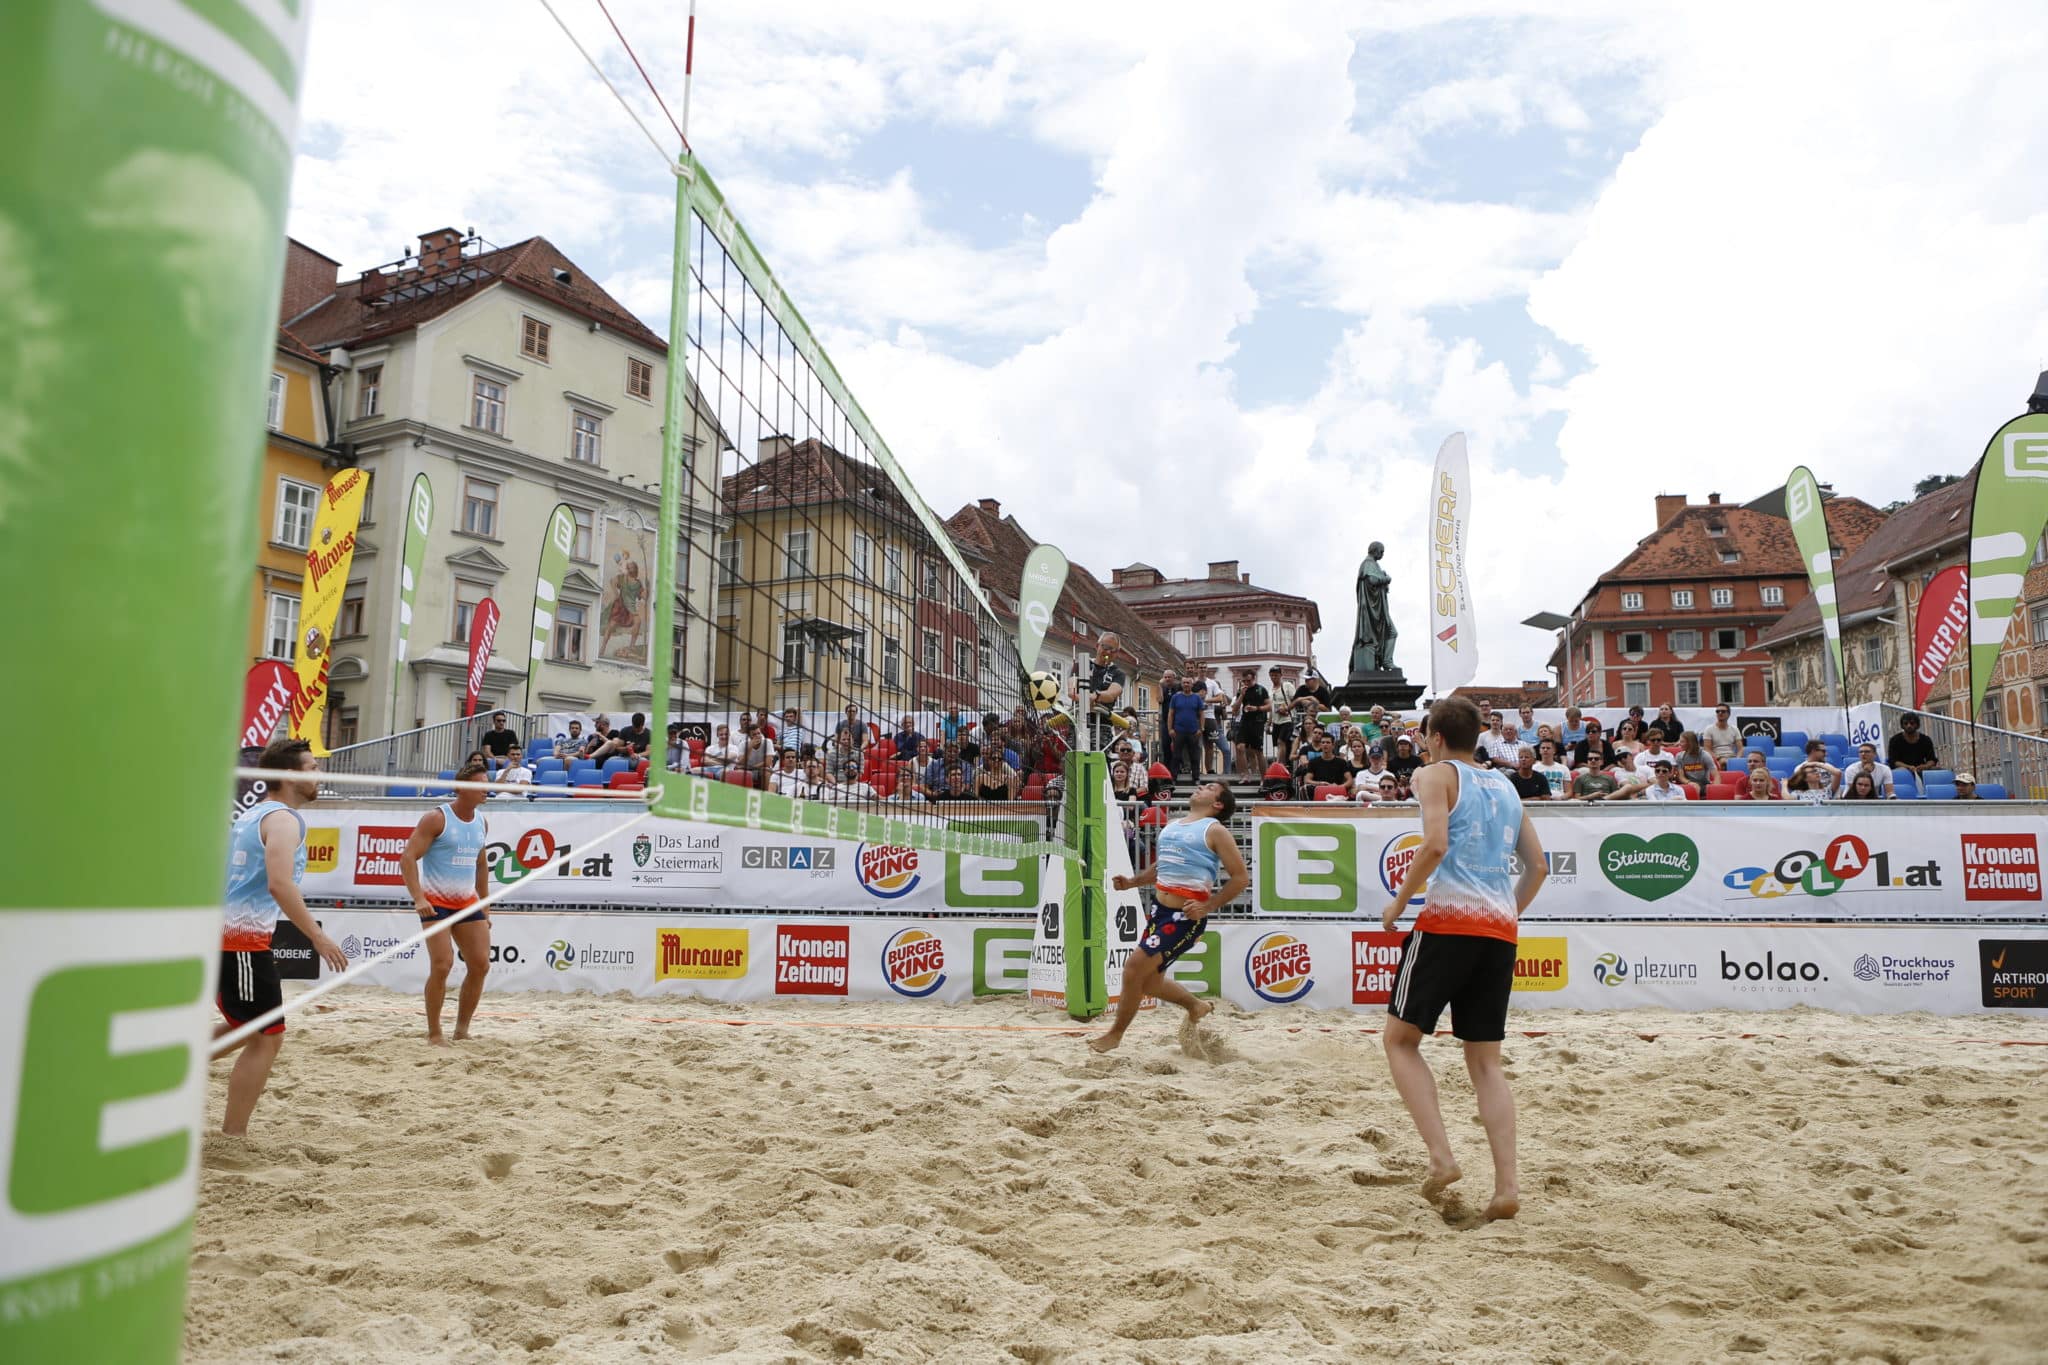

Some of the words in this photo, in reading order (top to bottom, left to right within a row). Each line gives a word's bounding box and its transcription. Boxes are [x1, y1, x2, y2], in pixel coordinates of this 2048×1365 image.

[1436, 471, 1457, 617] SCHERF
[307, 531, 355, 592] Murauer
[469, 601, 497, 697] CINEPLEXX
[1852, 720, 1880, 745] a&o
[659, 835, 682, 849] Das
[687, 835, 720, 849] Land
[357, 856, 403, 875] Zeitun
[654, 853, 720, 870] Steiermark
[743, 848, 835, 868] GRAZ
[1387, 850, 1419, 871] BUR
[1608, 850, 1691, 871] Steiermark
[1964, 843, 2036, 866] Kronen
[643, 875, 663, 885] Sport
[810, 870, 835, 879] SPORT
[865, 852, 918, 884] KING
[1967, 867, 2038, 892] Zeitung
[1550, 876, 1578, 886] SPORT
[581, 943, 634, 969] plezuro
[662, 934, 743, 974] Murauer
[779, 934, 846, 958] Kronen
[888, 939, 942, 964] BURGER
[1252, 944, 1308, 970] BURGER
[1355, 941, 1402, 965] Kron
[778, 960, 845, 987] Zeitung
[891, 951, 945, 983] KING
[1255, 957, 1311, 989] KING
[1514, 958, 1563, 978] auer
[1635, 956, 1697, 985] plezuro
[1721, 950, 1828, 981] bolao.
[1882, 956, 1955, 969] Druckhaus
[1356, 967, 1396, 992] Zeit
[1883, 969, 1950, 982] Thalerhof
[1994, 987, 2037, 999] SPORT
